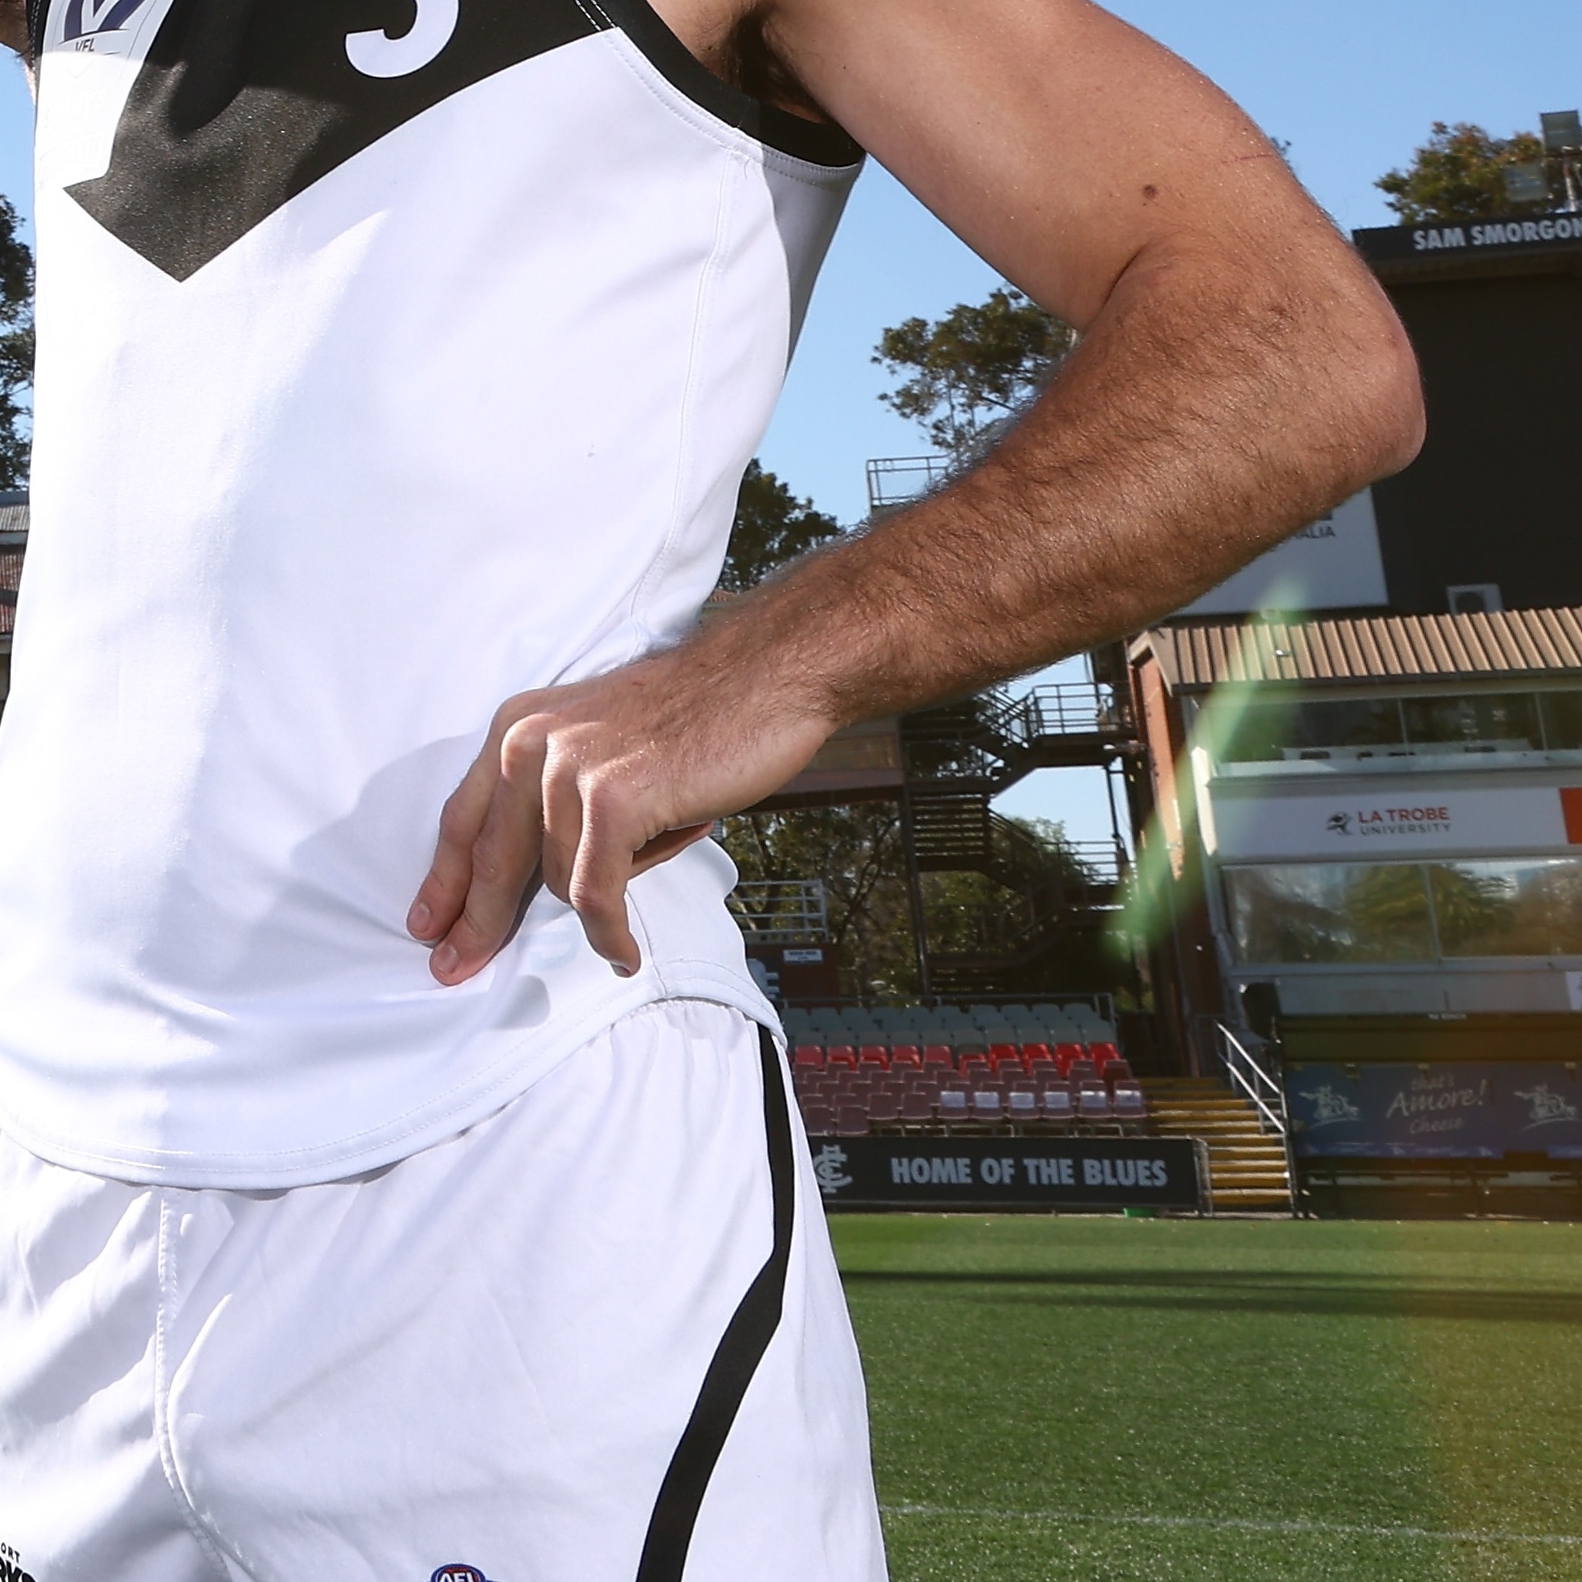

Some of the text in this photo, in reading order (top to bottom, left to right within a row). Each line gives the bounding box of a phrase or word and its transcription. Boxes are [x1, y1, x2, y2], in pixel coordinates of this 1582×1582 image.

[75, 37, 96, 52] VFL
[1412, 227, 1467, 251] SAM
[1357, 806, 1450, 824] LA TROBE
[1360, 823, 1452, 836] UNIVERSITY
[890, 1157, 1169, 1188] HOME OF THE BLUES
